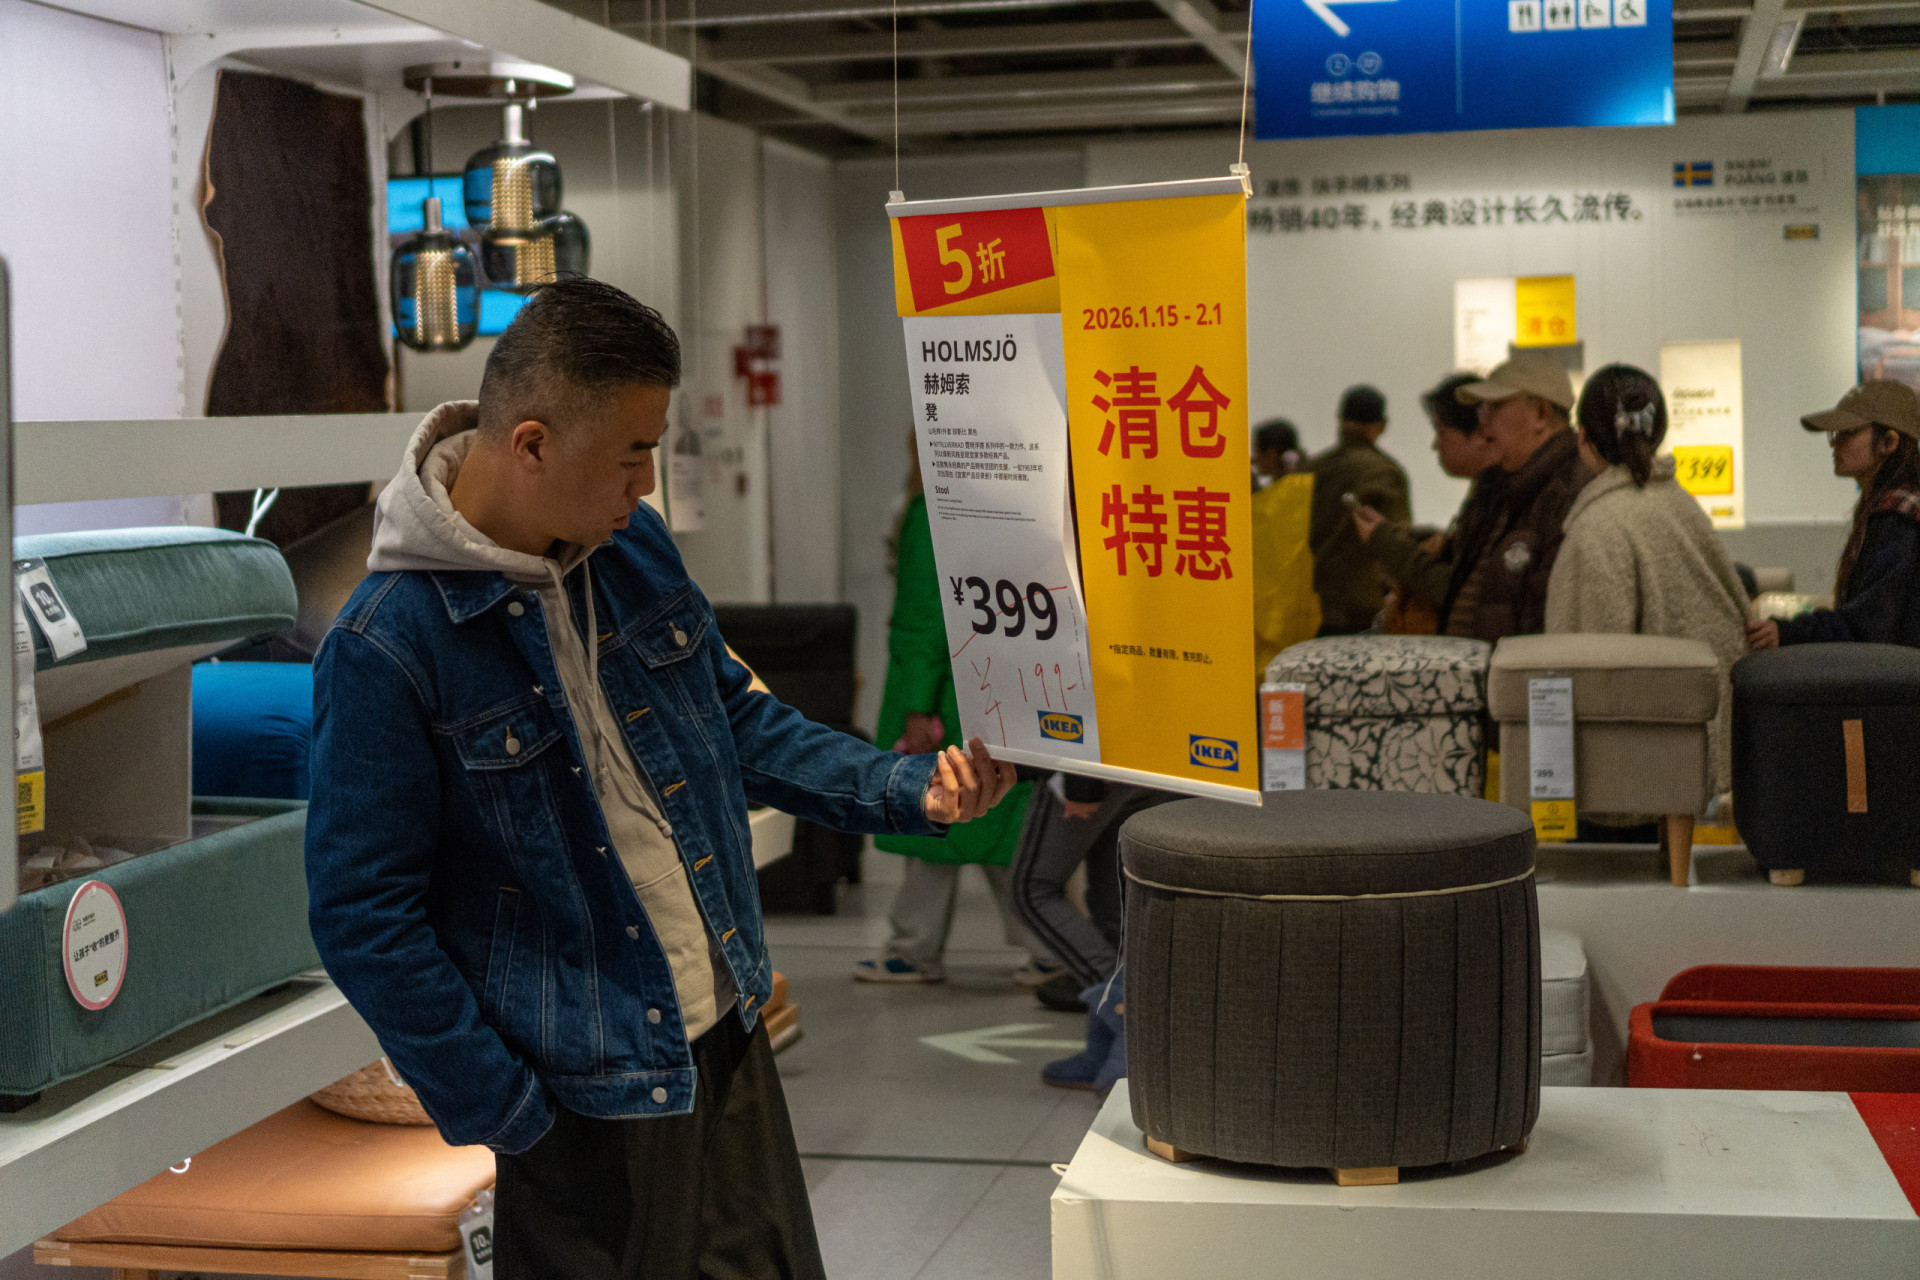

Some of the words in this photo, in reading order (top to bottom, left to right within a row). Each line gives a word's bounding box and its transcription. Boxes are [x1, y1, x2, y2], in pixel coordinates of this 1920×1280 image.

[935, 223, 1006, 295] 5折
[1083, 305, 1178, 330] 2026.1.15
[1196, 303, 1222, 326] 2.1
[922, 333, 1017, 362] HOLMSJÖ
[924, 372, 970, 395] 赫姆索
[925, 402, 938, 421] 凳
[1091, 364, 1231, 459] 清仓
[935, 485, 950, 495] Stool
[1101, 484, 1233, 581] 特惠
[950, 576, 1058, 641] ¥399
[1043, 719, 1080, 734] IKEA
[1195, 744, 1235, 762] IKEA
